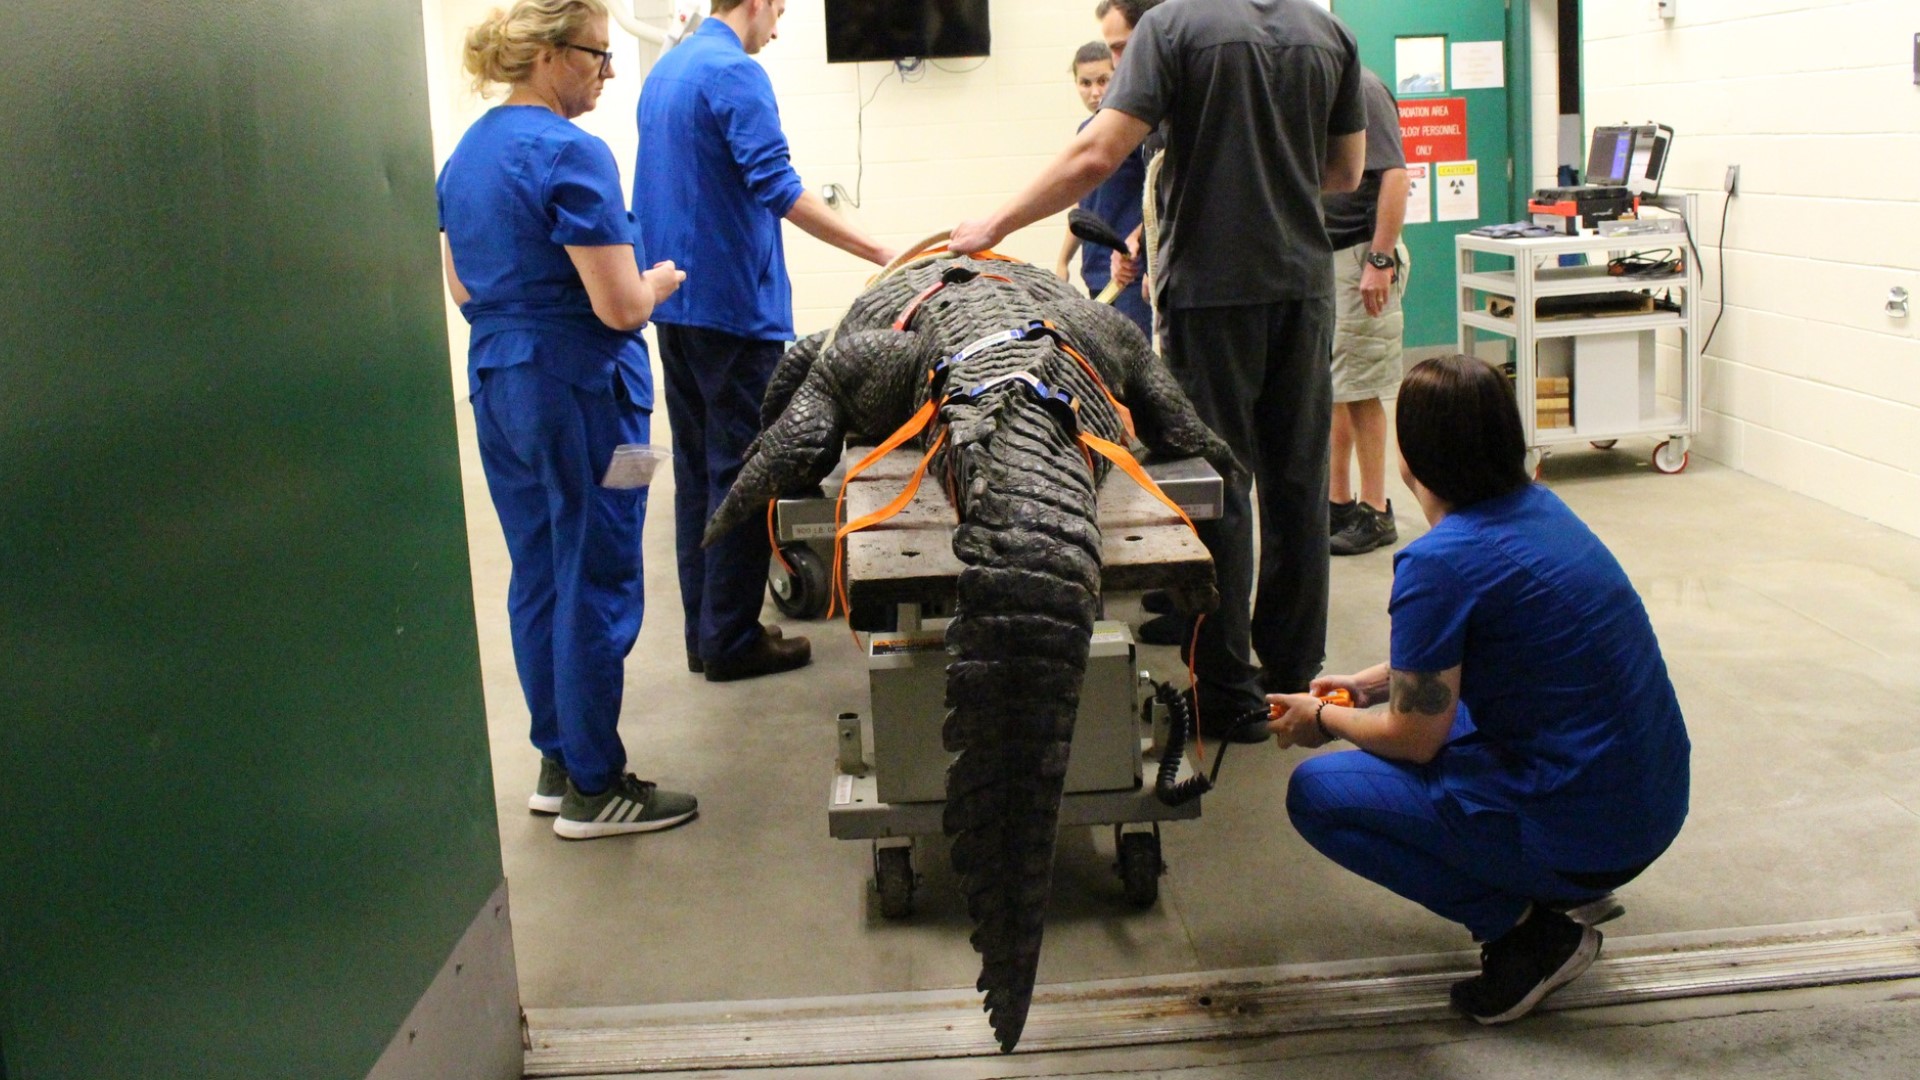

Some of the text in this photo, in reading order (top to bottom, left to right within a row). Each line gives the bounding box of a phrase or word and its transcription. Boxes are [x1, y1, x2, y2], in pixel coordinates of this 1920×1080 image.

[1431, 105, 1449, 116] AREA
[1400, 124, 1461, 137] OLOGY PERSONNEL
[1416, 145, 1432, 156] ONLY
